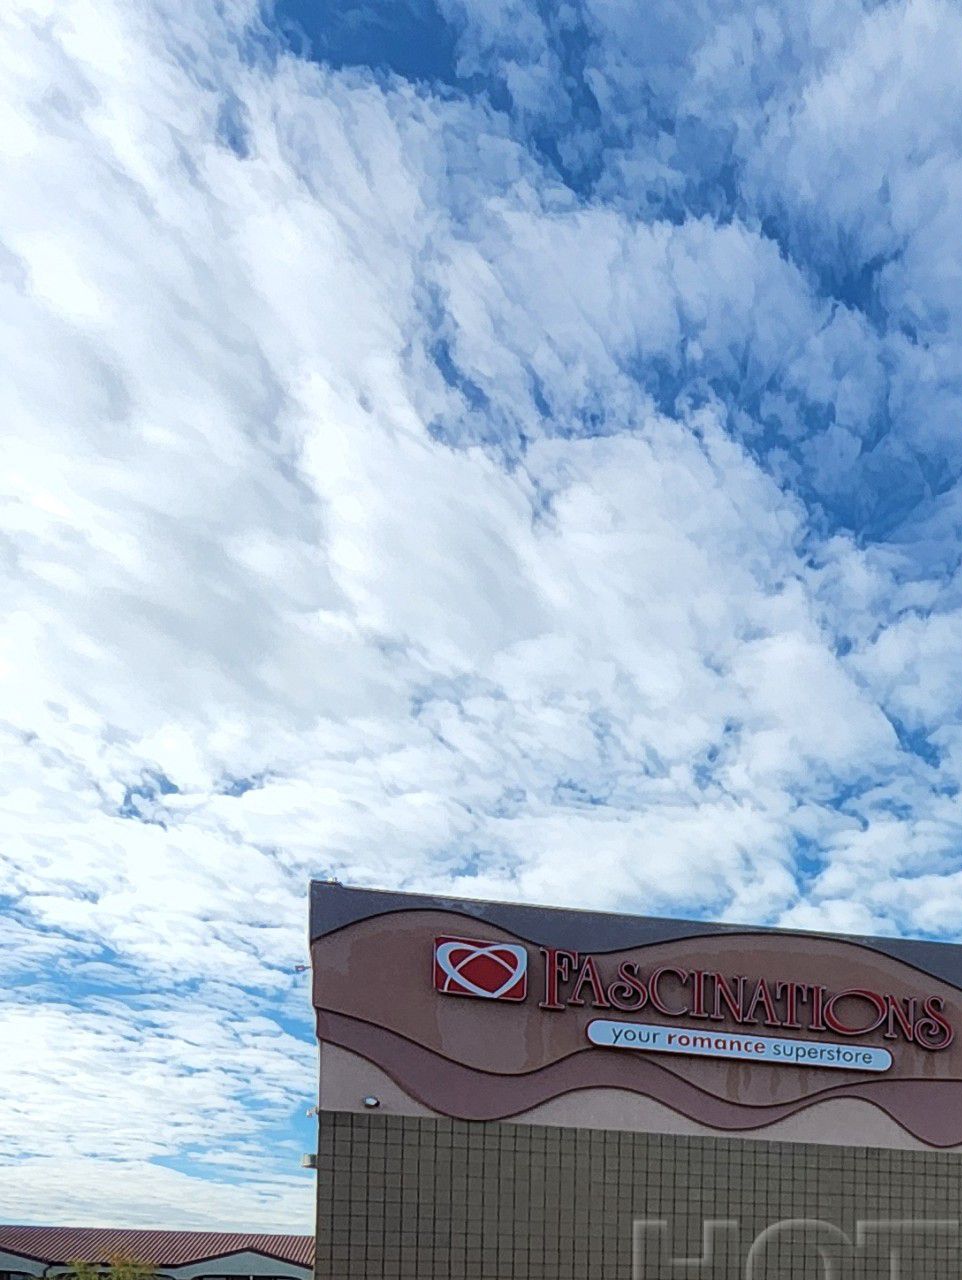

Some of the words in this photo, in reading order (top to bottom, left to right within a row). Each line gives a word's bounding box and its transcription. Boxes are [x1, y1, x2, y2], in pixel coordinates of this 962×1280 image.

[539, 947, 954, 1050] FASCINATIONS
[611, 1026, 660, 1046] your
[667, 1032, 767, 1055] romance
[772, 1042, 873, 1067] superstore
